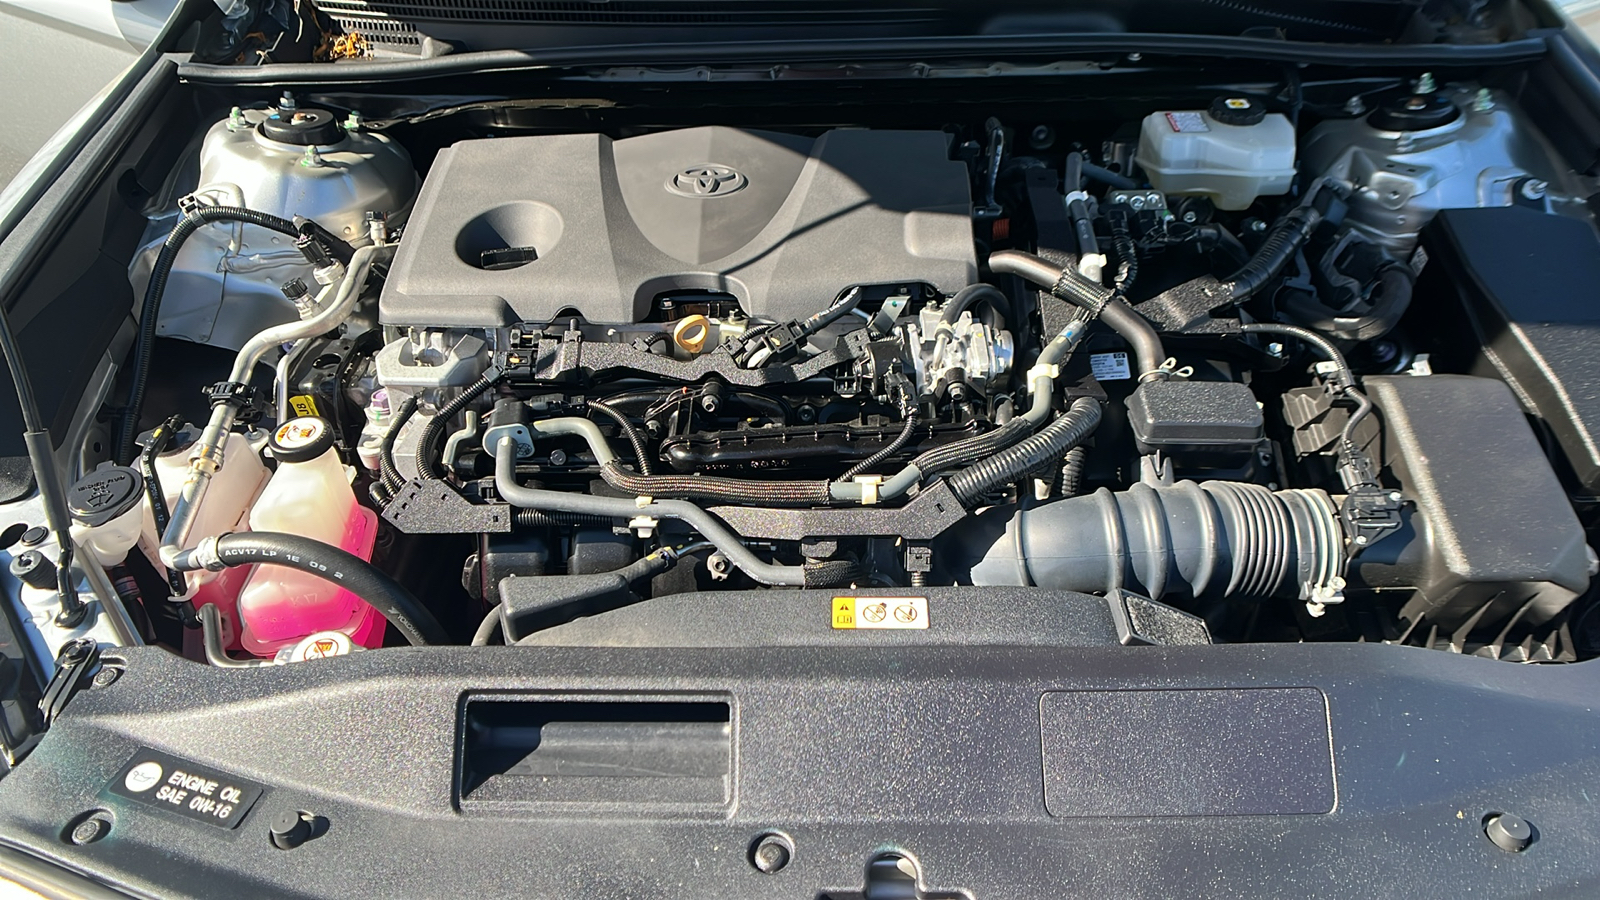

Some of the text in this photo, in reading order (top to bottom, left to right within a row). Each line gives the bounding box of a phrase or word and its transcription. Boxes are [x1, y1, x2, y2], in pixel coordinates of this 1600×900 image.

[224, 548, 258, 557] ACV17
[155, 785, 233, 819] SAE 0W-16
[167, 770, 242, 804] ENGINE OIL
